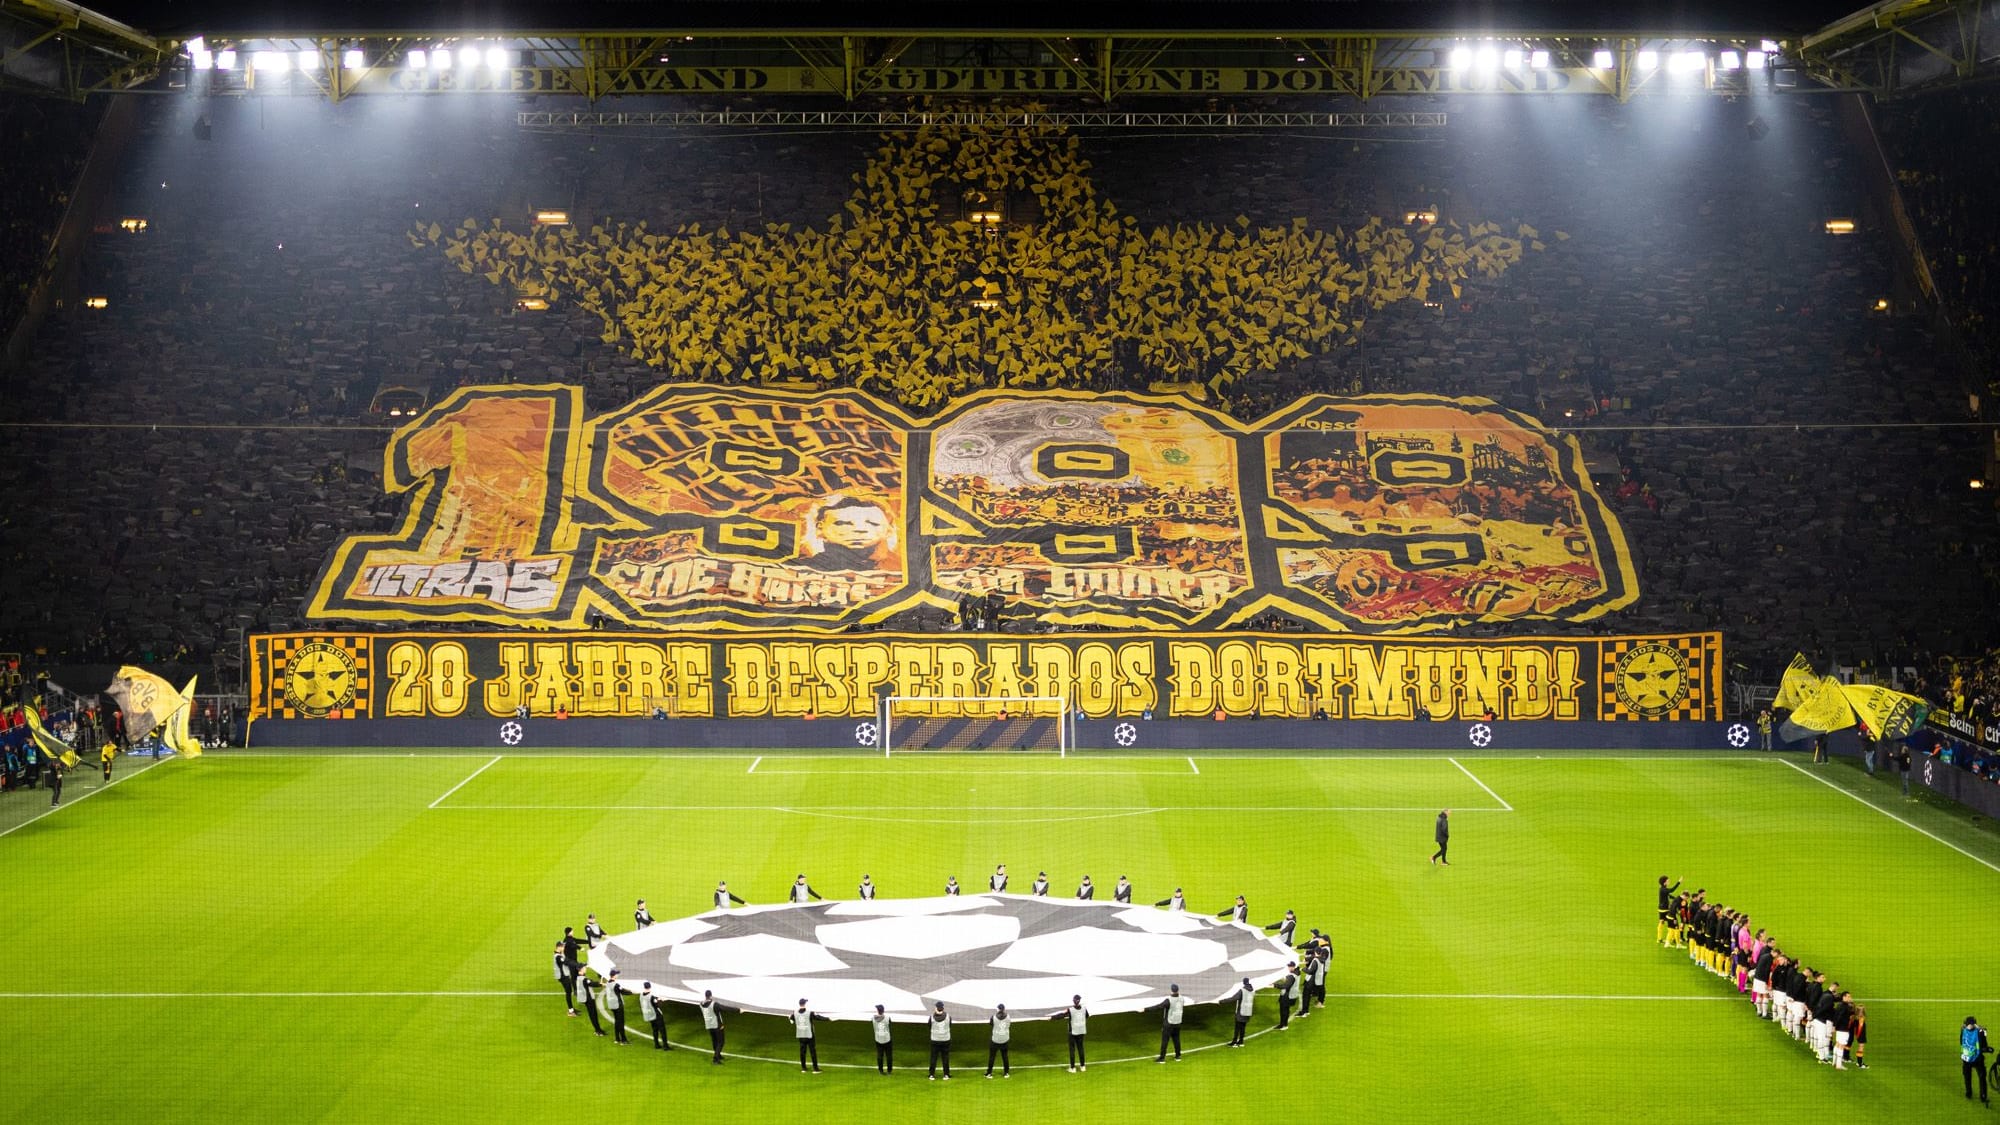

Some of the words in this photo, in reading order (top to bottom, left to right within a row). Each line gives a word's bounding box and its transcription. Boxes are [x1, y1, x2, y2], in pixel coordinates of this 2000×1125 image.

[608, 67, 768, 91] WAND
[363, 558, 561, 610] ULTRAS
[607, 557, 718, 597] EINE
[131, 683, 156, 709] BVB
[387, 642, 475, 717] 20
[484, 642, 714, 717] JAHRE
[724, 642, 1158, 717] DESPERADOS
[1167, 641, 1584, 720] DORTMUND!
[1617, 645, 1655, 710] DESPERADOS
[1659, 646, 1686, 709] DORTMUND
[1867, 686, 1885, 711] BVB
